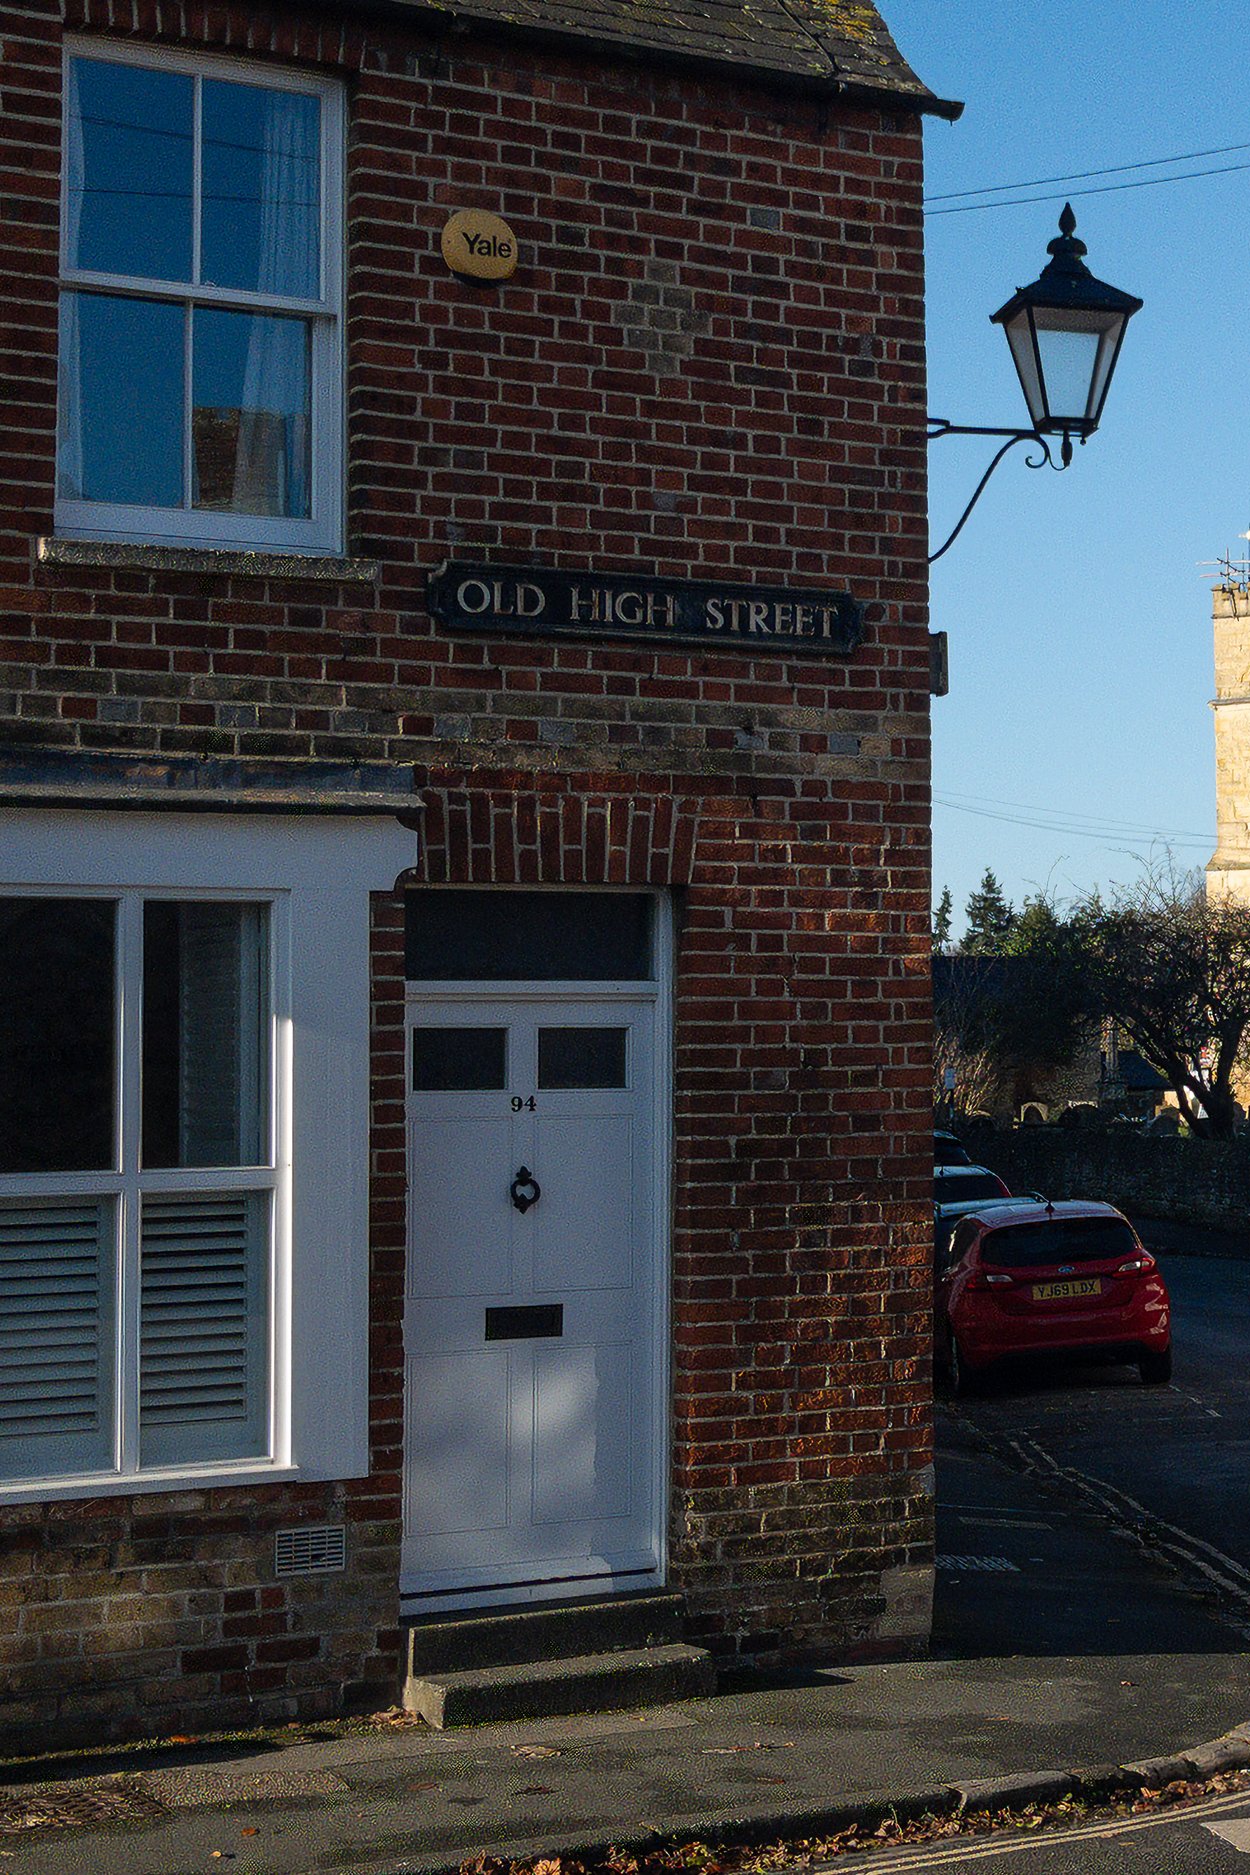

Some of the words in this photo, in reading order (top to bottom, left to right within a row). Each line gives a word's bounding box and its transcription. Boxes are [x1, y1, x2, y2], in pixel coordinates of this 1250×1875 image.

[461, 231, 512, 259] Yale
[457, 579, 546, 617] OLD
[569, 584, 675, 627] HIGH
[705, 597, 840, 639] STREET
[510, 1095, 537, 1112] 94
[1038, 1284, 1069, 1298] YJ69
[1072, 1281, 1096, 1295] LDX
